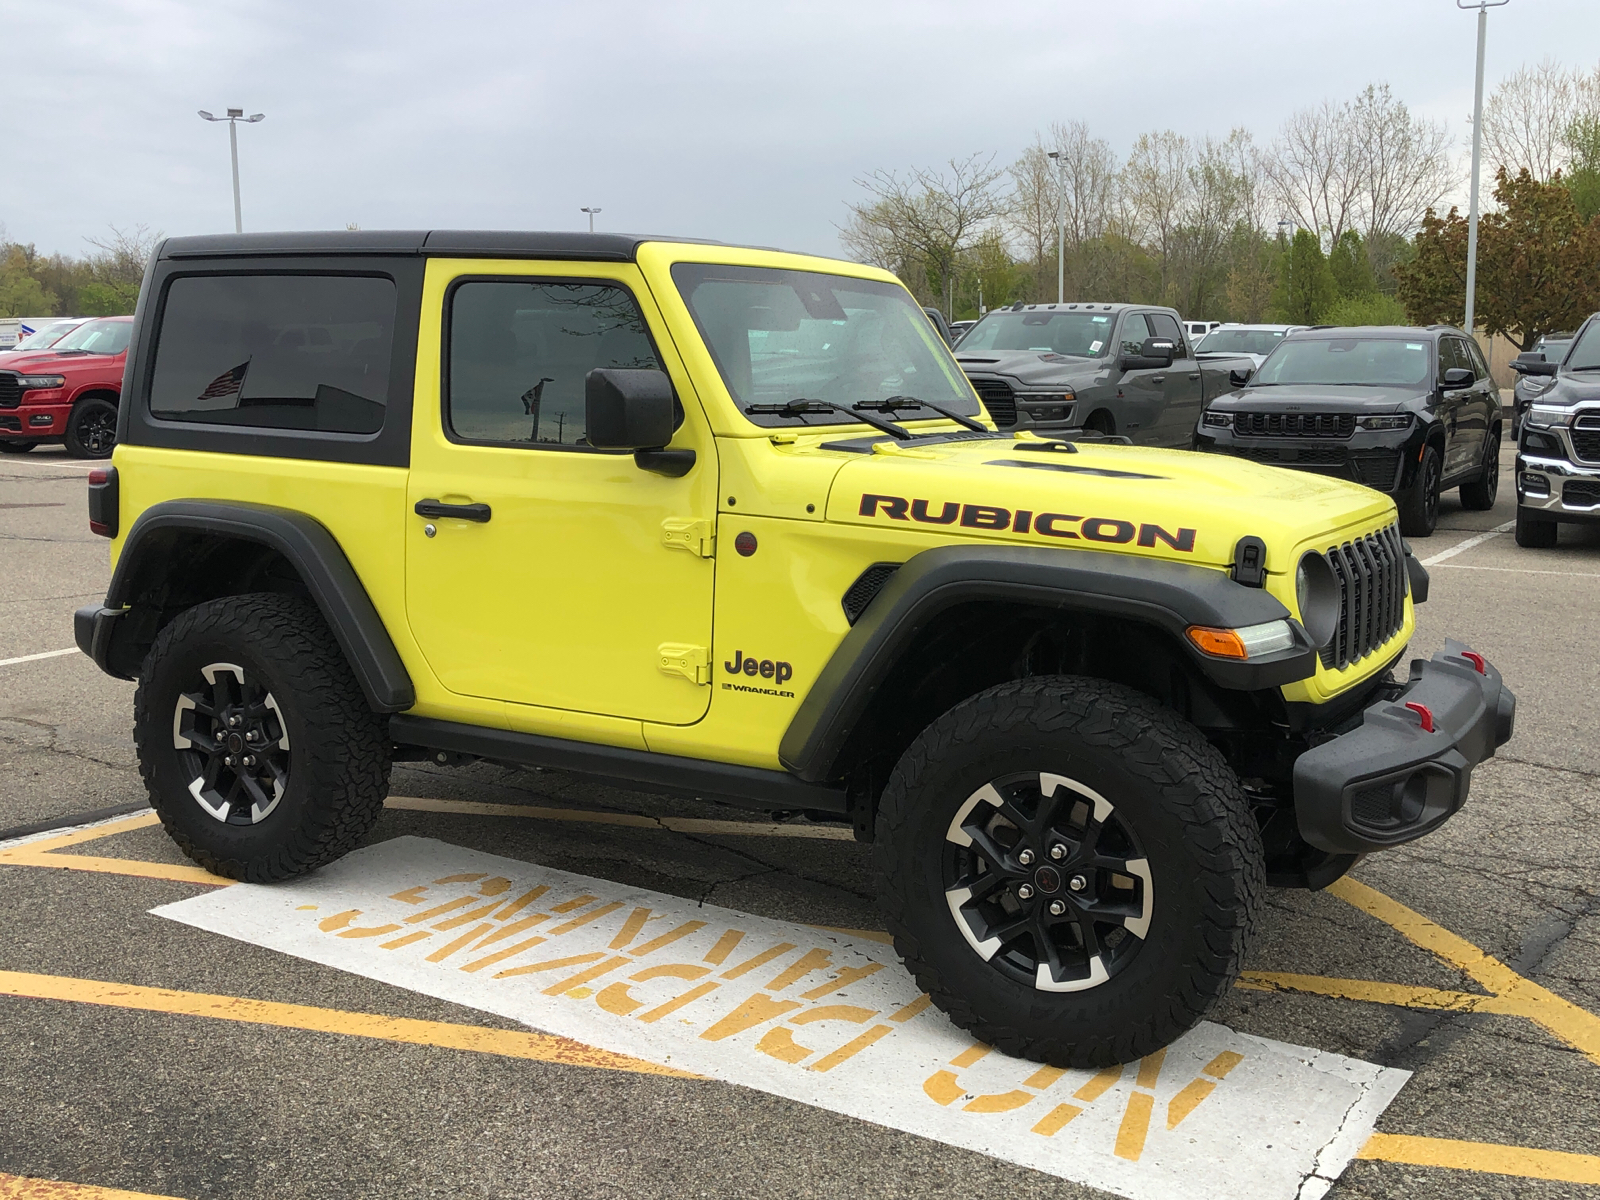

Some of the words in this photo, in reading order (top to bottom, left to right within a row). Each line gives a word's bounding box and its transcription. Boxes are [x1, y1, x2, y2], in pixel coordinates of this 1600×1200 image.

[858, 493, 1197, 553] RUBICON
[724, 650, 793, 685] Jeep
[732, 684, 795, 699] WRANGLER
[319, 873, 932, 1073] PARKING
